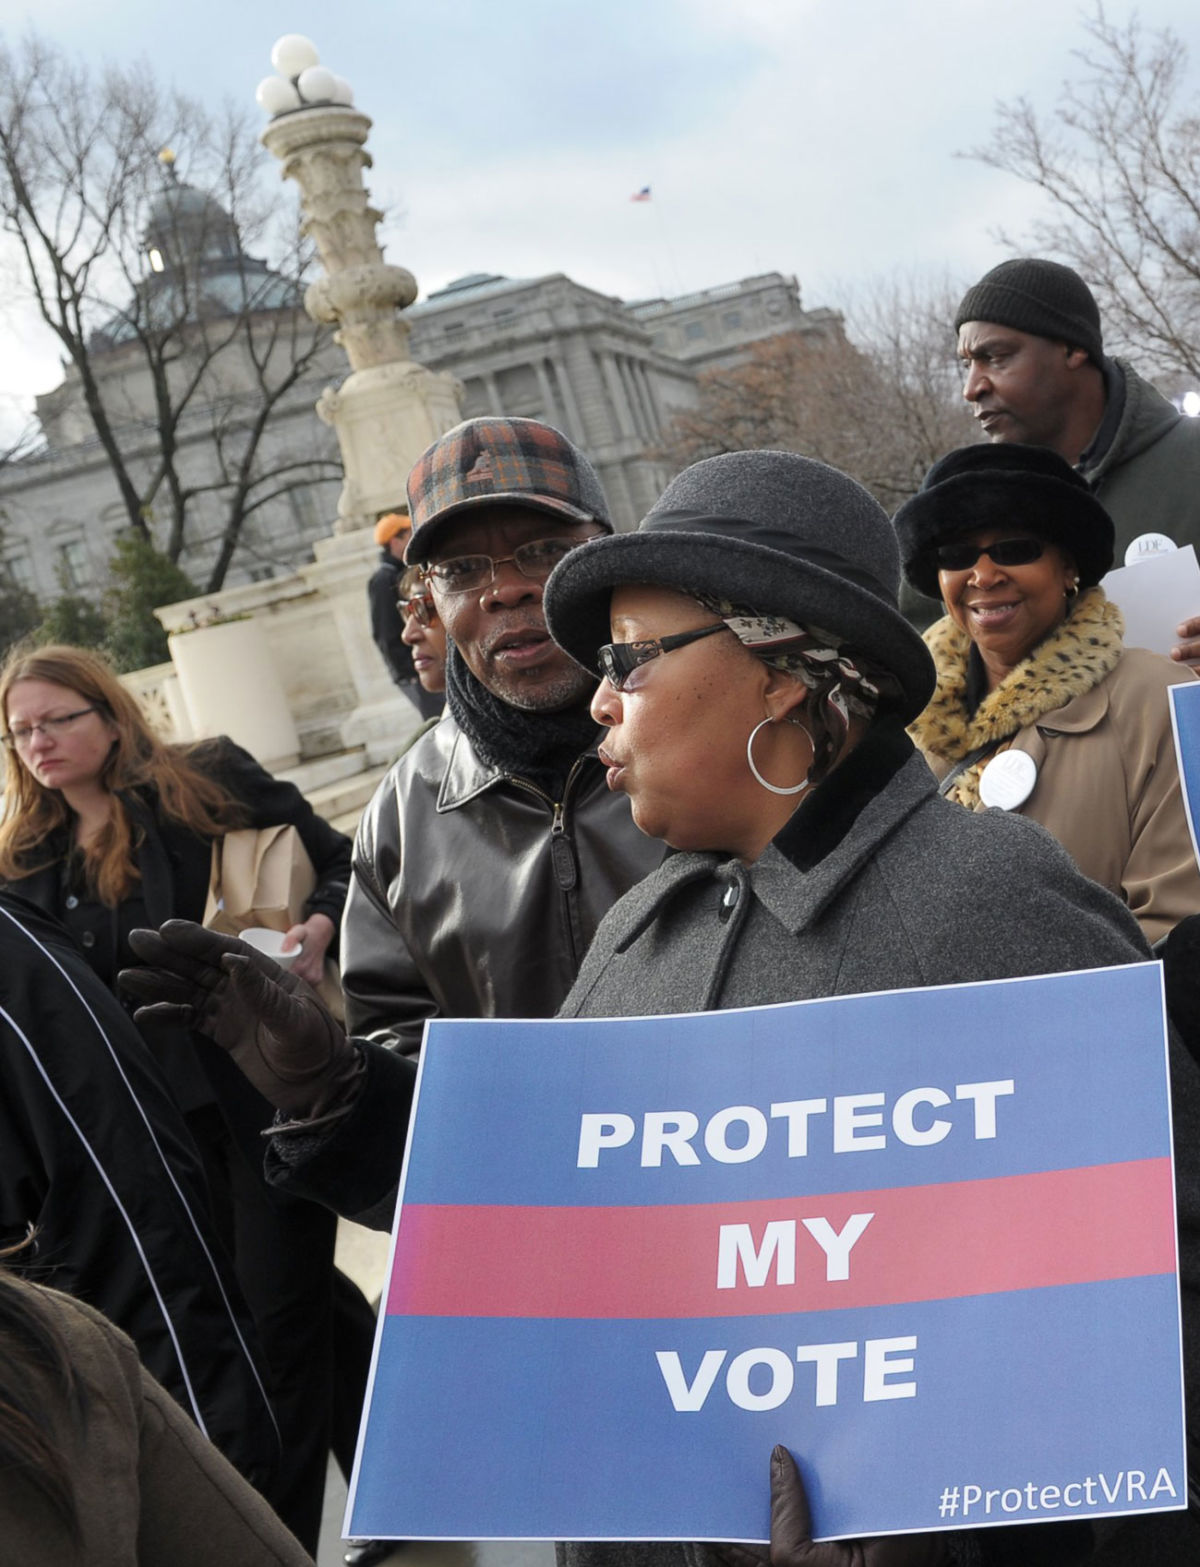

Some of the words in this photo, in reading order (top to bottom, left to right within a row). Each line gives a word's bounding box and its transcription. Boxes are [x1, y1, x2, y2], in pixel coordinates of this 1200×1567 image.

[577, 1079, 1015, 1168] PROTECT
[716, 1212, 875, 1290] MY
[655, 1335, 918, 1413] VOTE
[938, 1467, 1178, 1518] #ProtectVRA
